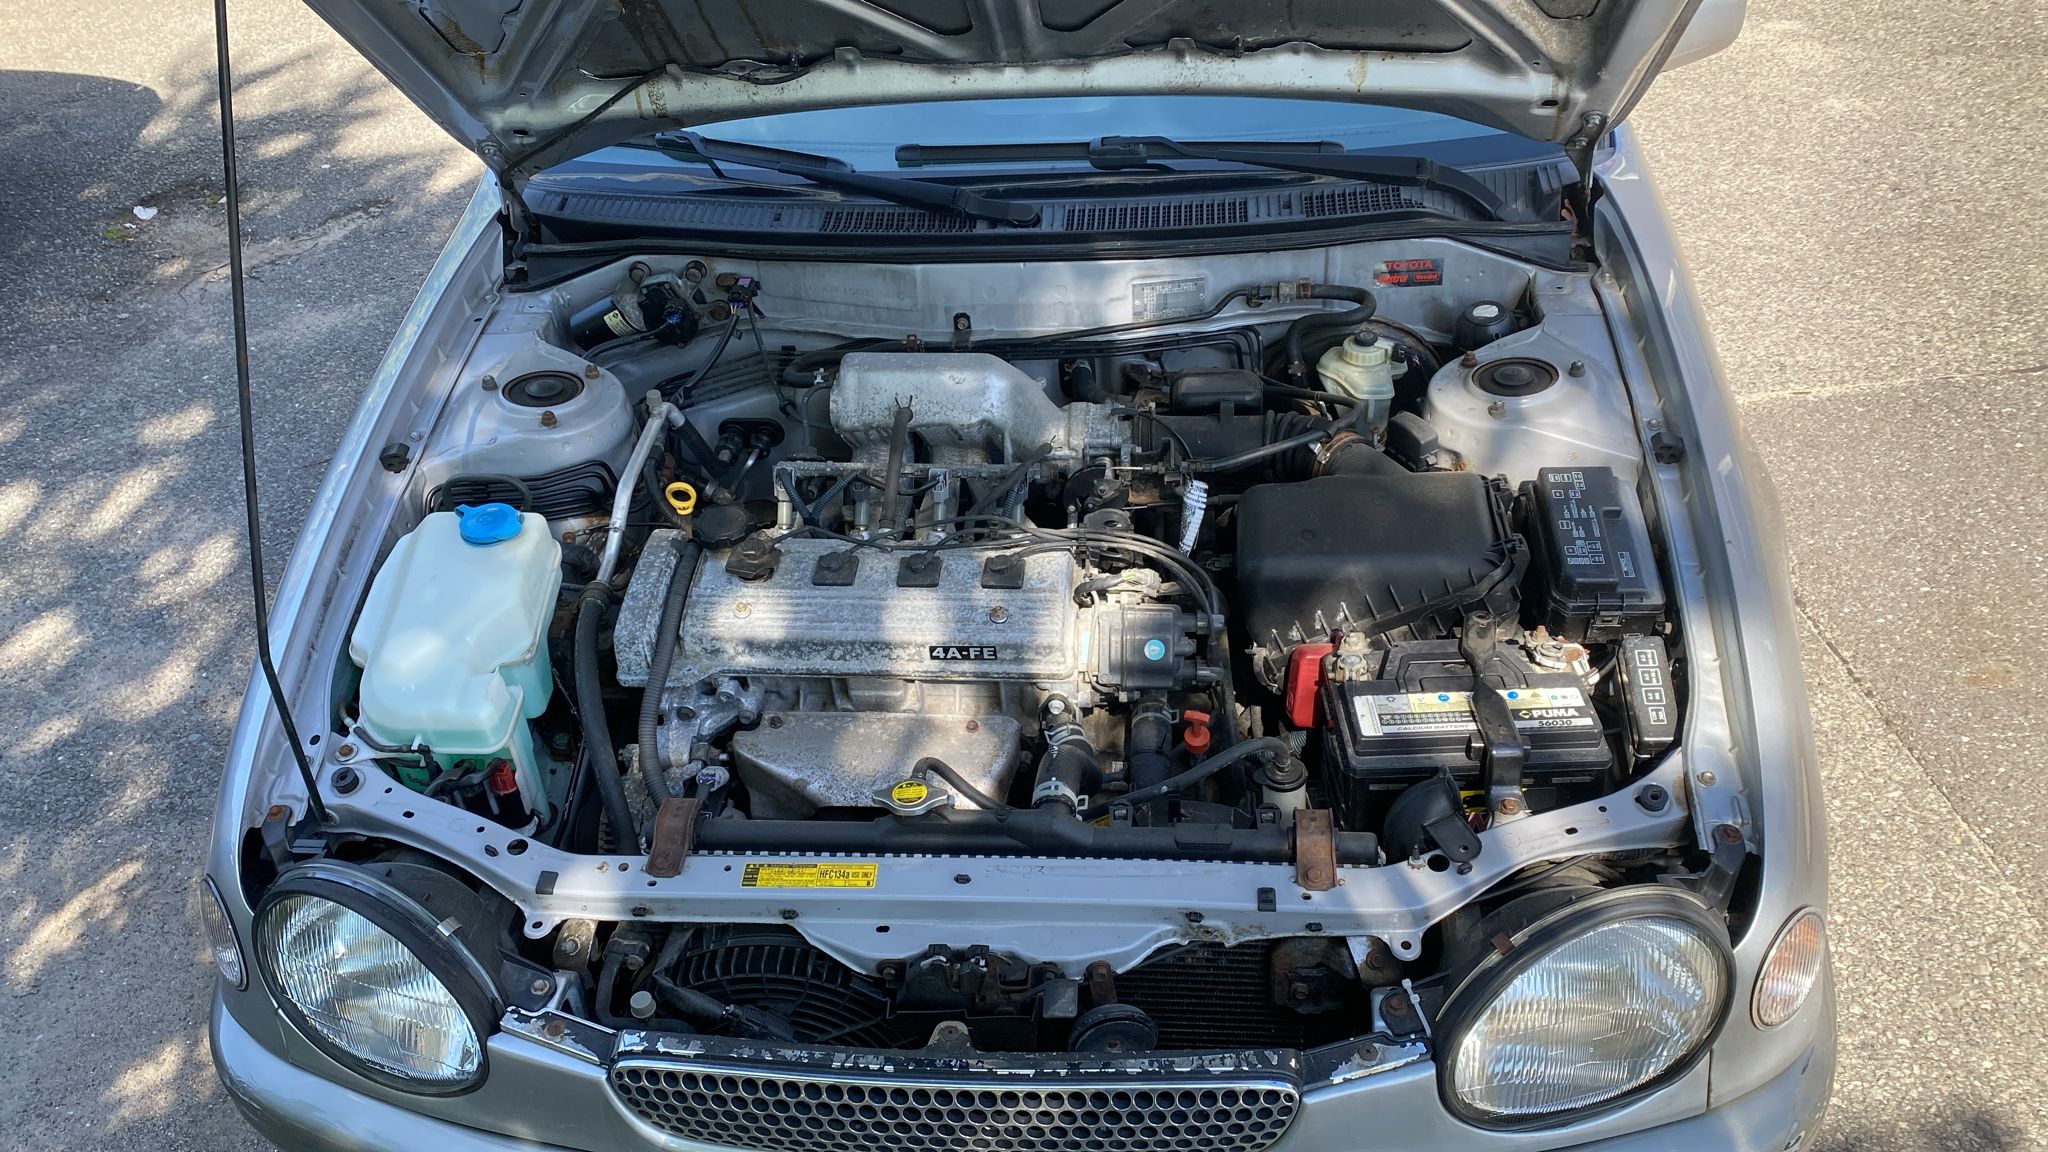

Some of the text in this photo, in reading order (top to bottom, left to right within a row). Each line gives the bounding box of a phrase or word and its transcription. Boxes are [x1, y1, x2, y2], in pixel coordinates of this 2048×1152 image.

[1385, 261, 1432, 270] TOYOTA
[931, 647, 996, 659] 4A-FE
[1532, 708, 1579, 718] PUMA
[820, 870, 850, 879] HFC134a
